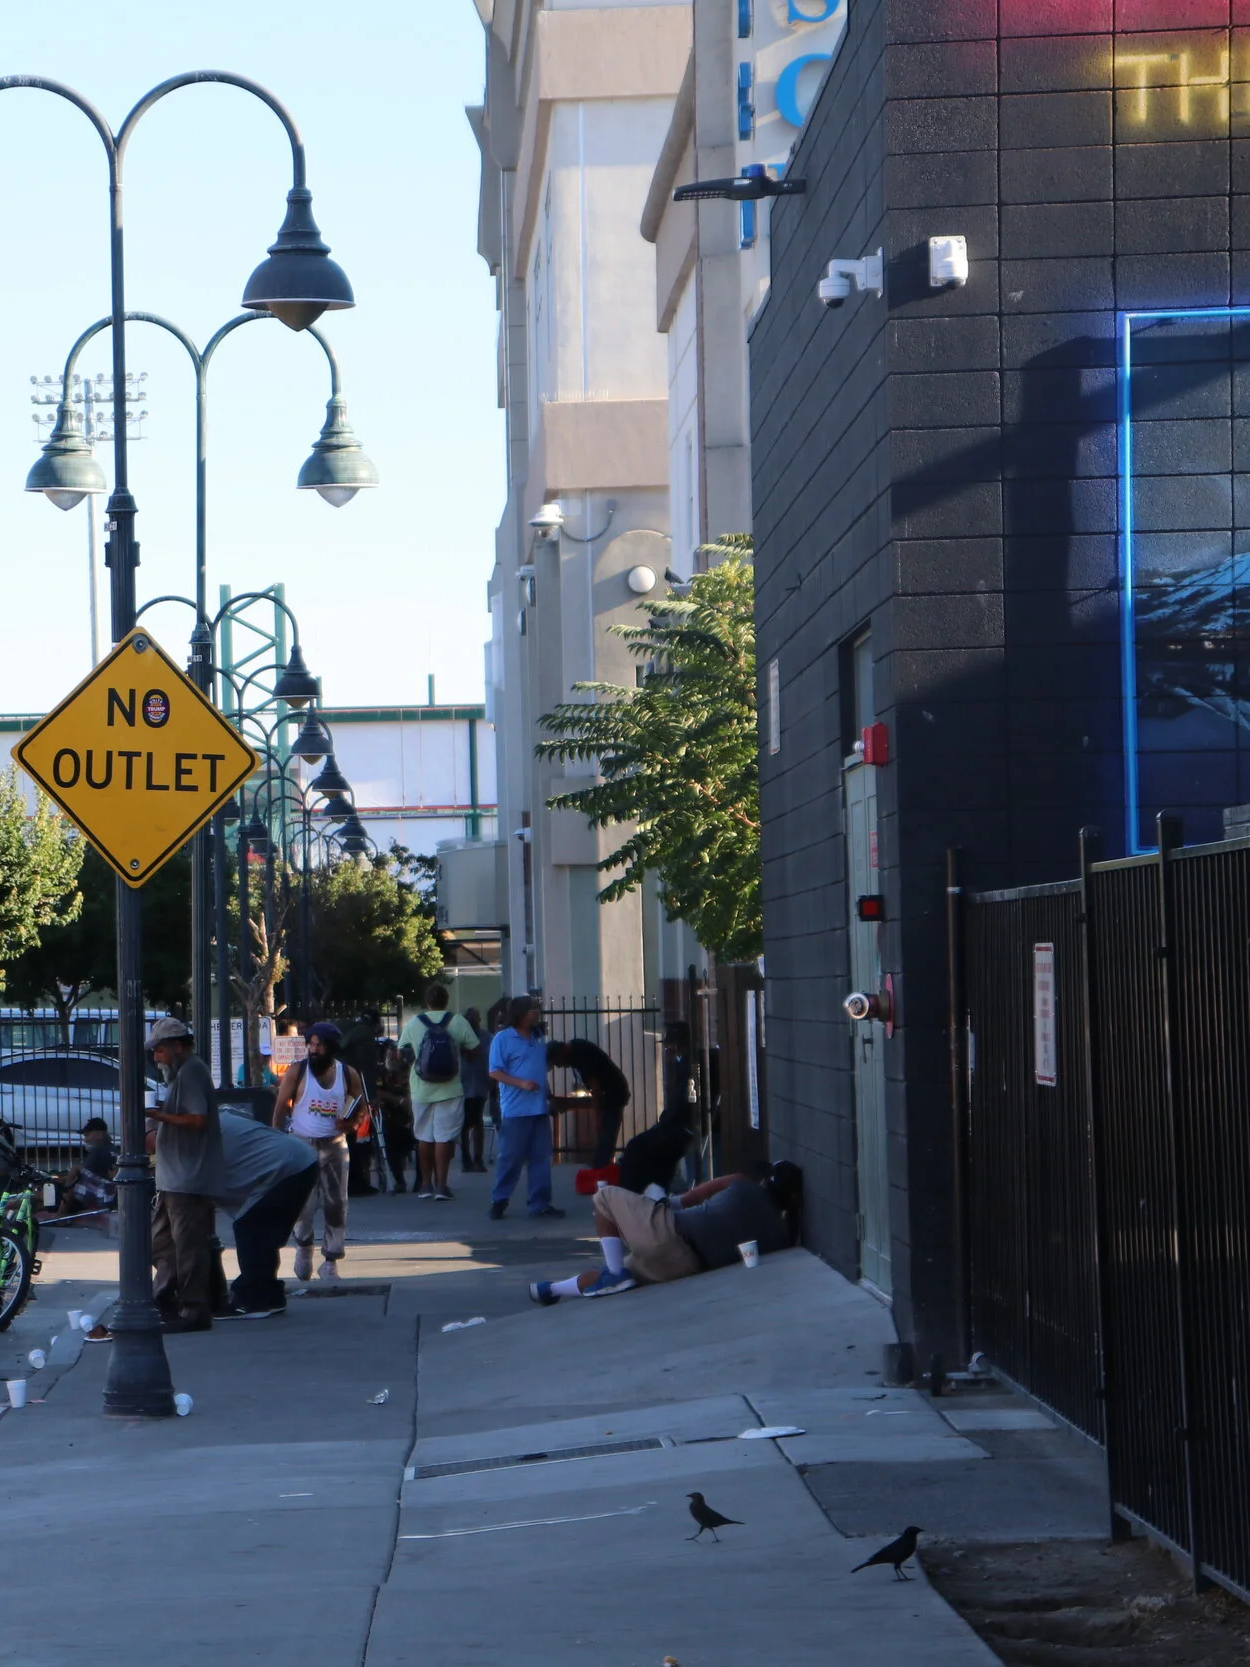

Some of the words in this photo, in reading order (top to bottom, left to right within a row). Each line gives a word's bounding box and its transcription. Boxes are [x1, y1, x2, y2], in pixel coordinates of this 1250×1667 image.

[1112, 50, 1250, 120] TH
[107, 688, 171, 728] NO
[52, 748, 226, 793] OUTLET
